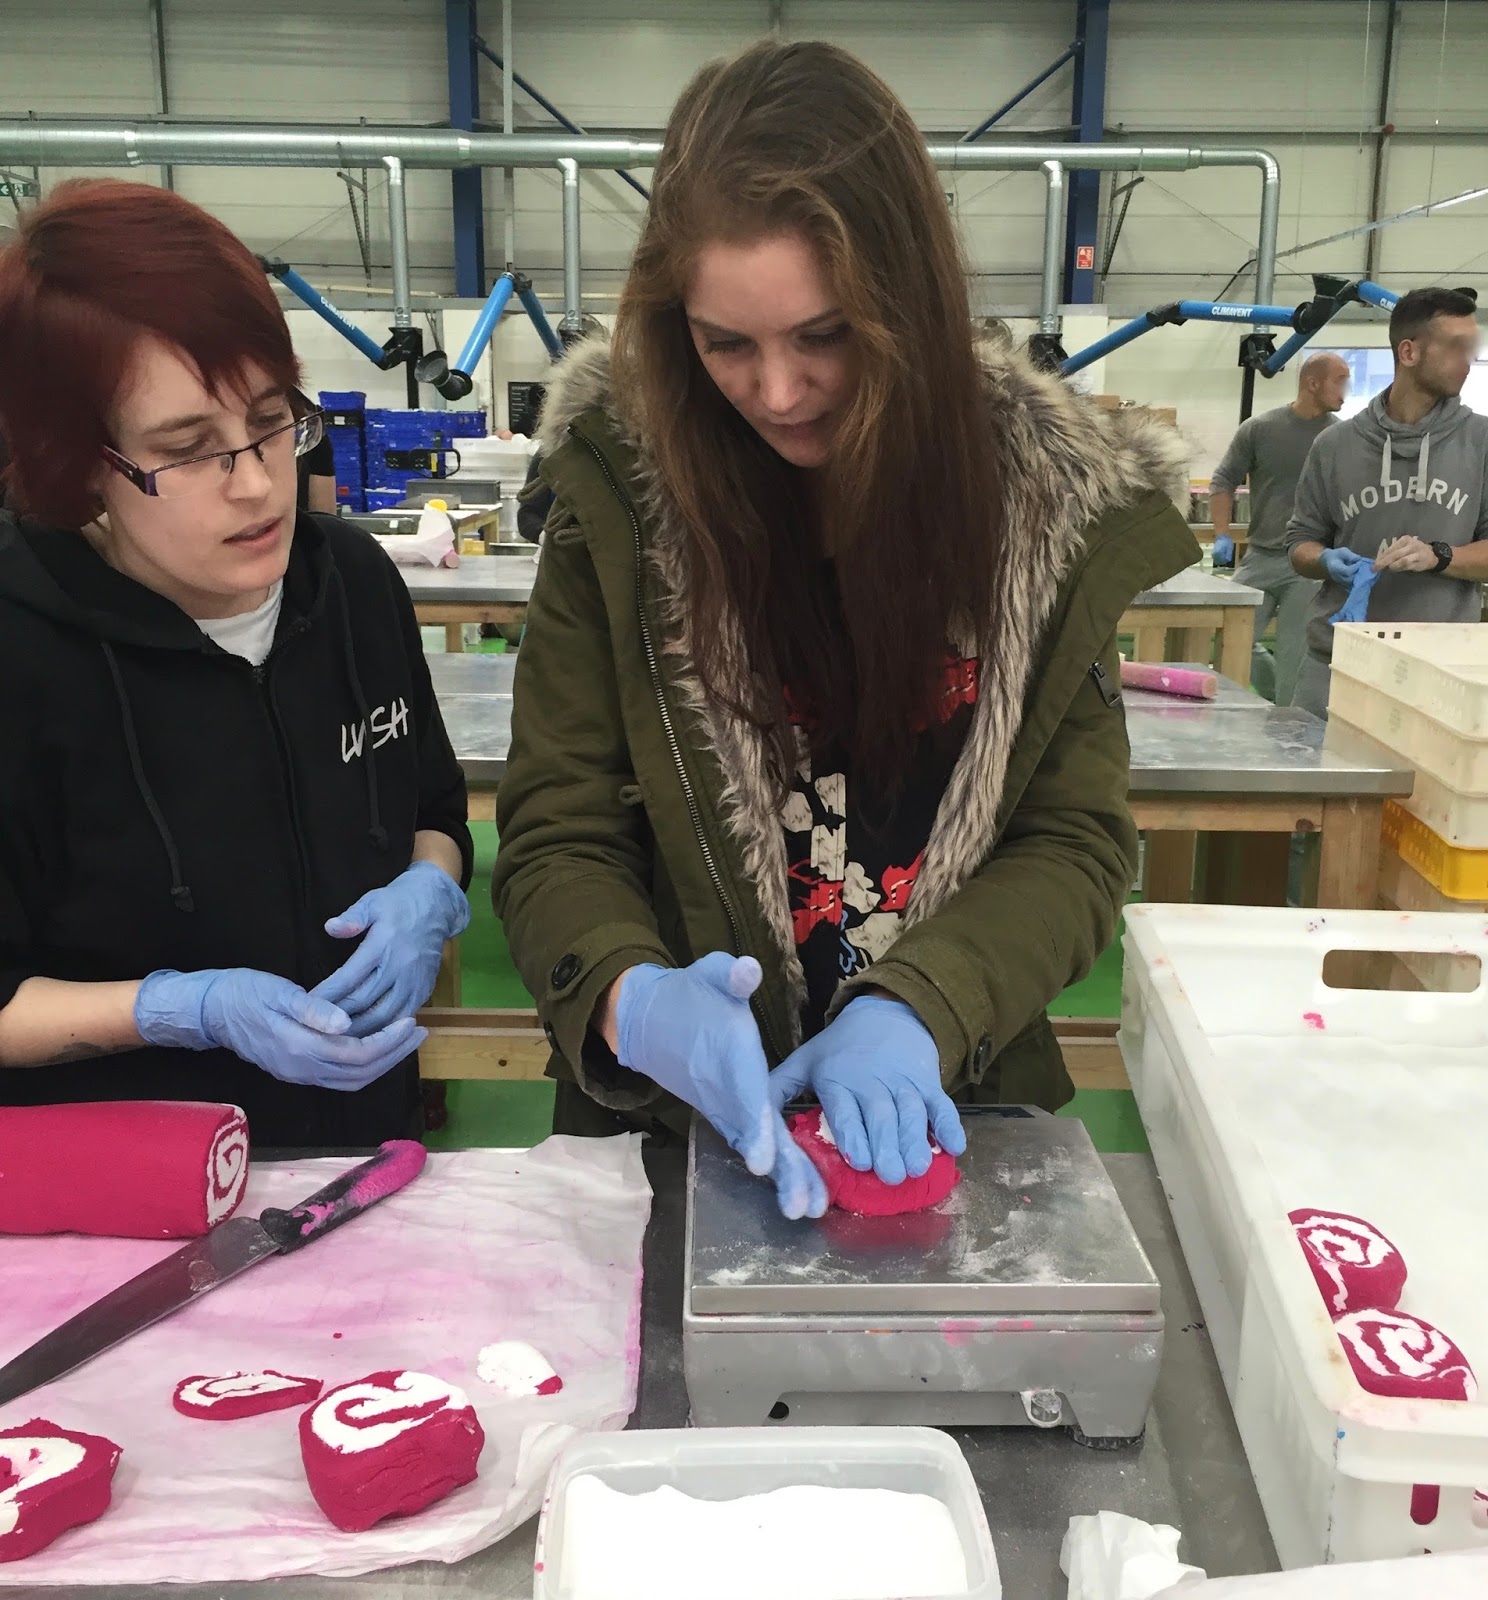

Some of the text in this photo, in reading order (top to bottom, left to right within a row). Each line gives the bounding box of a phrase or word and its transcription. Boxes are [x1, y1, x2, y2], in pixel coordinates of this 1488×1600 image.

[1211, 306, 1253, 317] CLIMAVENT
[1340, 475, 1469, 521] MODERN
[341, 697, 409, 763] LUSH
